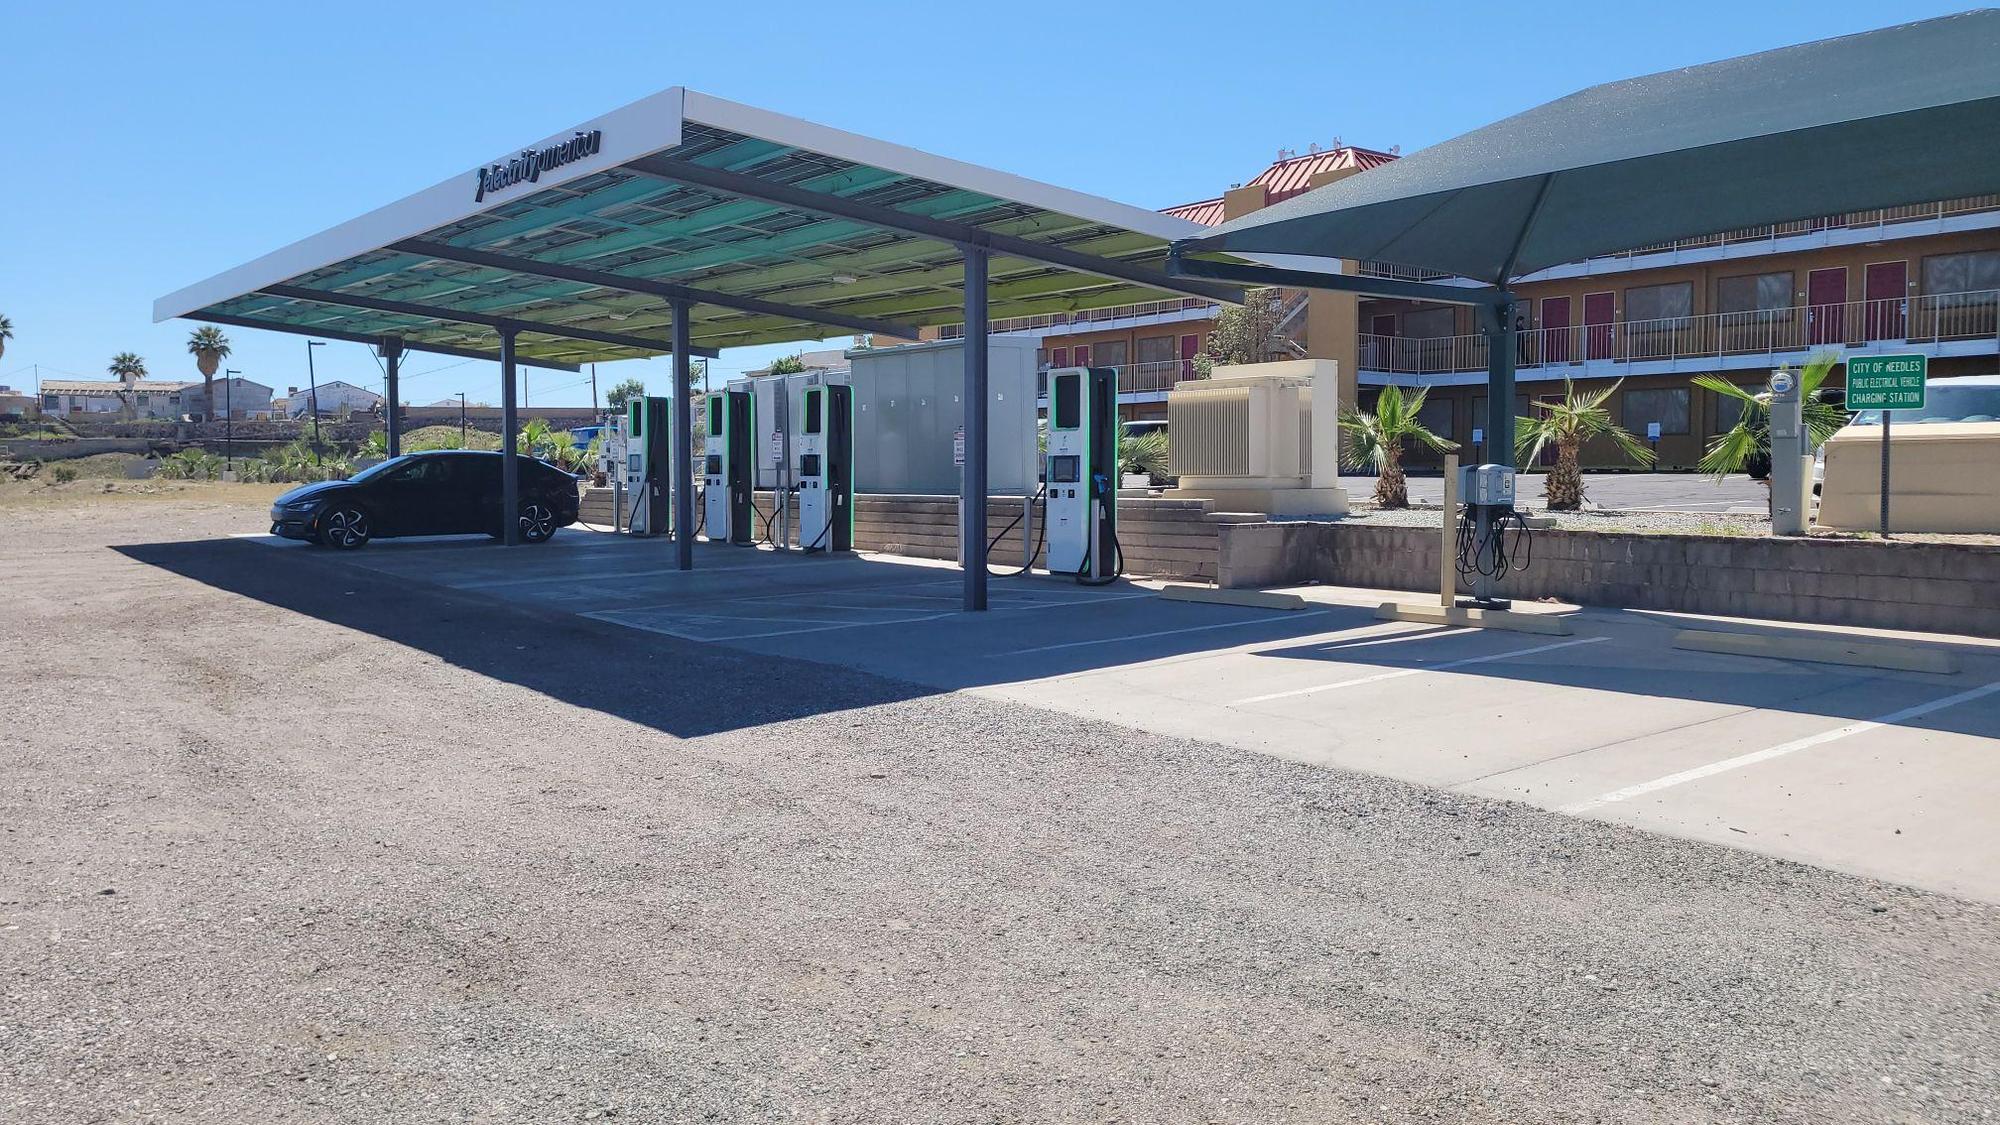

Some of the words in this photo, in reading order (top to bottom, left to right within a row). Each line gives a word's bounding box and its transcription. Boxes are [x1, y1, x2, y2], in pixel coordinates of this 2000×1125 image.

[1852, 362, 1870, 374] CITY
[1872, 362, 1885, 373] OF
[1886, 360, 1921, 373] NEEDLES
[1852, 378, 1869, 389] PUBLIC
[1900, 376, 1920, 387] VEHICLE
[1851, 392, 1887, 404] CHARGING
[1889, 391, 1920, 403] STATION
